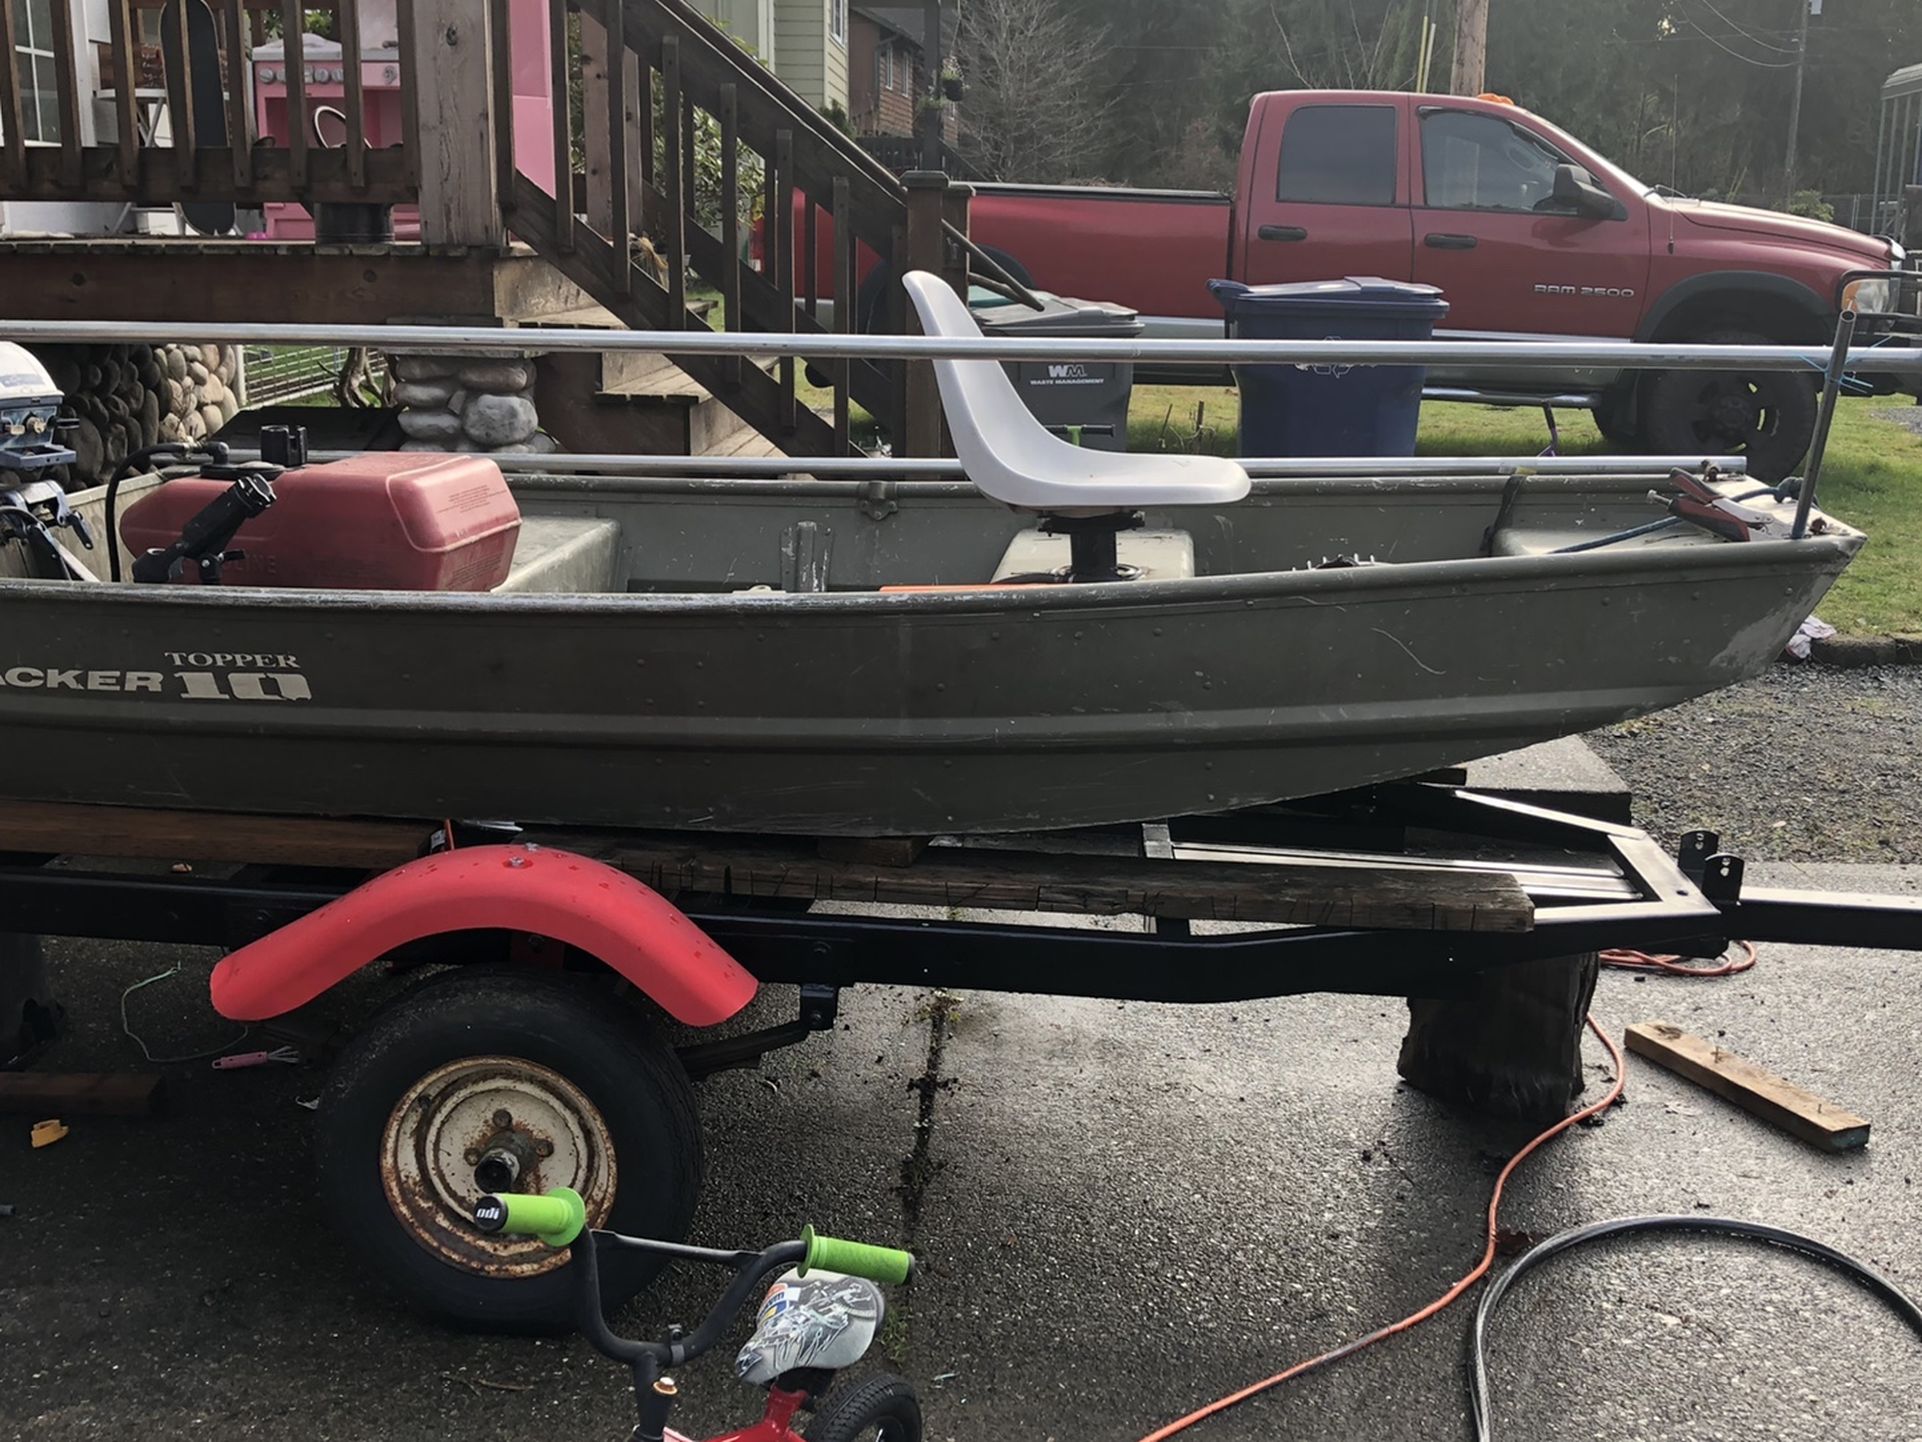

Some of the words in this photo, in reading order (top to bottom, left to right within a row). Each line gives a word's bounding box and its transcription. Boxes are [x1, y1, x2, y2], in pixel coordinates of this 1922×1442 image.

[1534, 283, 1576, 295] RAM
[1580, 286, 1635, 298] 2500
[1047, 364, 1088, 378] WM
[1055, 377, 1105, 385] MANAGEMENT
[164, 651, 301, 668] TOPPER
[0, 666, 164, 692] CKER
[173, 671, 312, 701] 10
